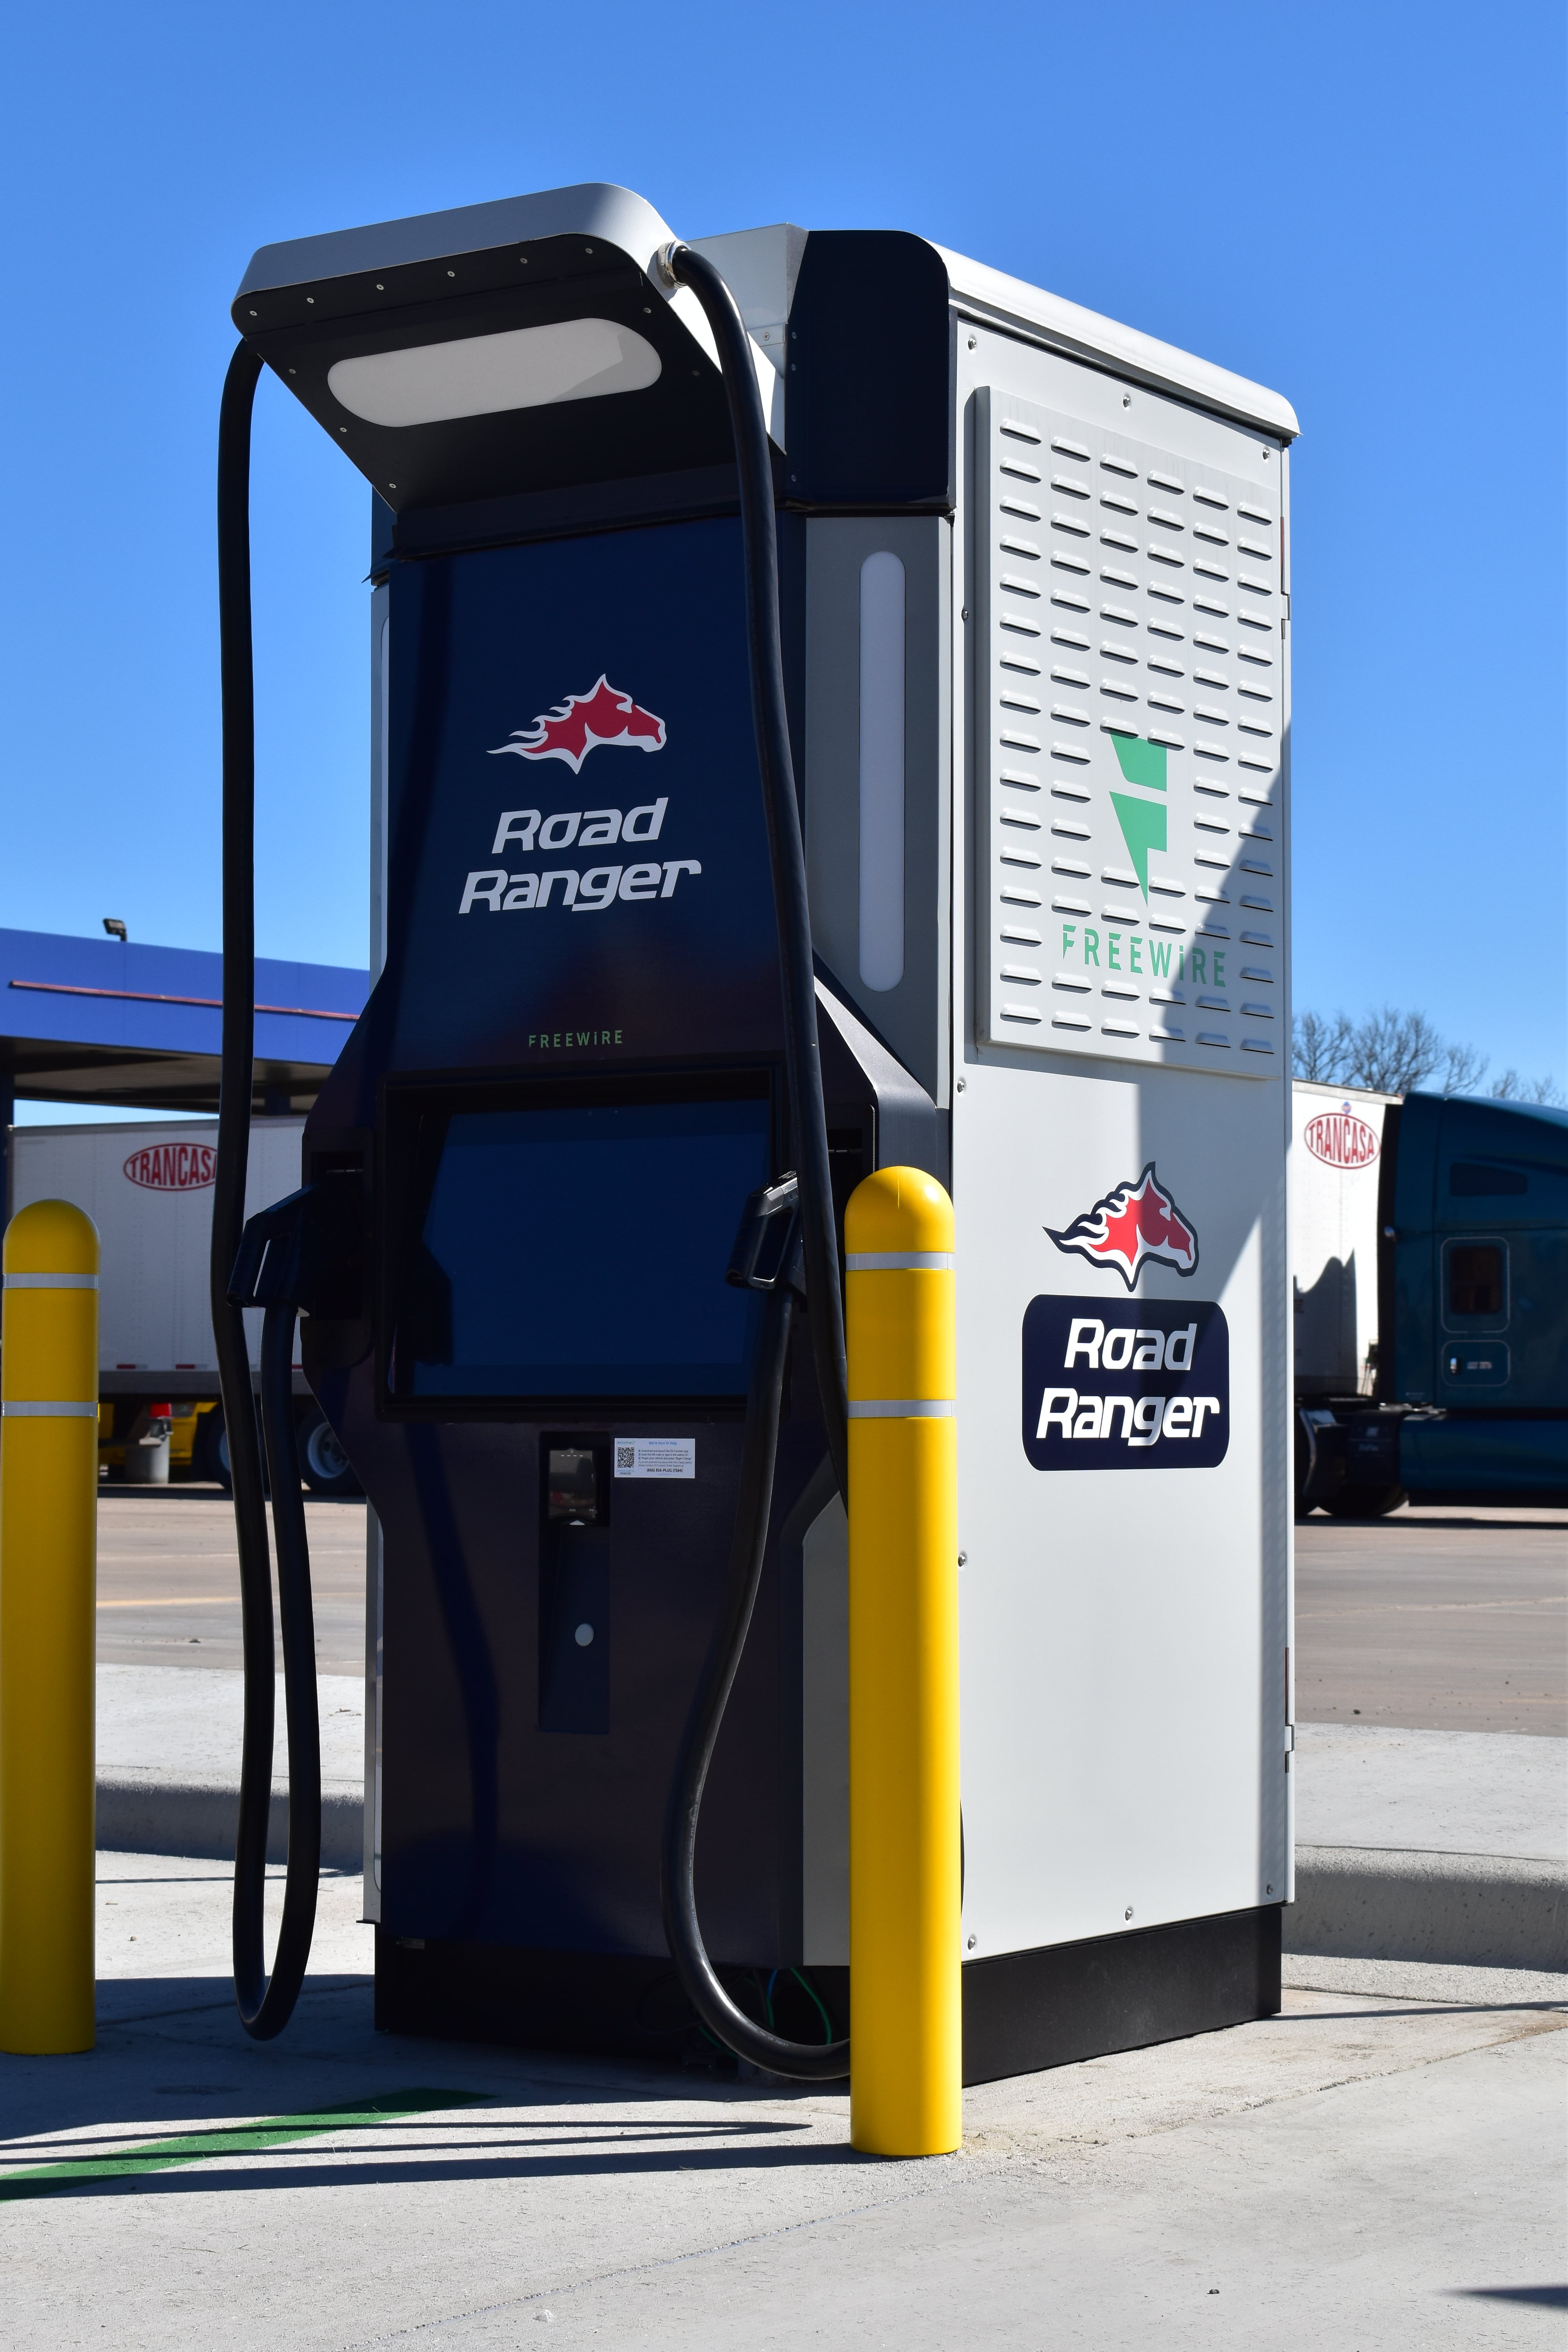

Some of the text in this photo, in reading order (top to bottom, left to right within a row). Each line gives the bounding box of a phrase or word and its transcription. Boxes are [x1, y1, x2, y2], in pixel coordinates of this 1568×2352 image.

[492, 797, 668, 854] Road
[459, 860, 701, 914] Ranger
[1310, 1117, 1374, 1164] TRANCASA
[1064, 1318, 1197, 1370] Road
[1036, 1388, 1220, 1446] Ranger
